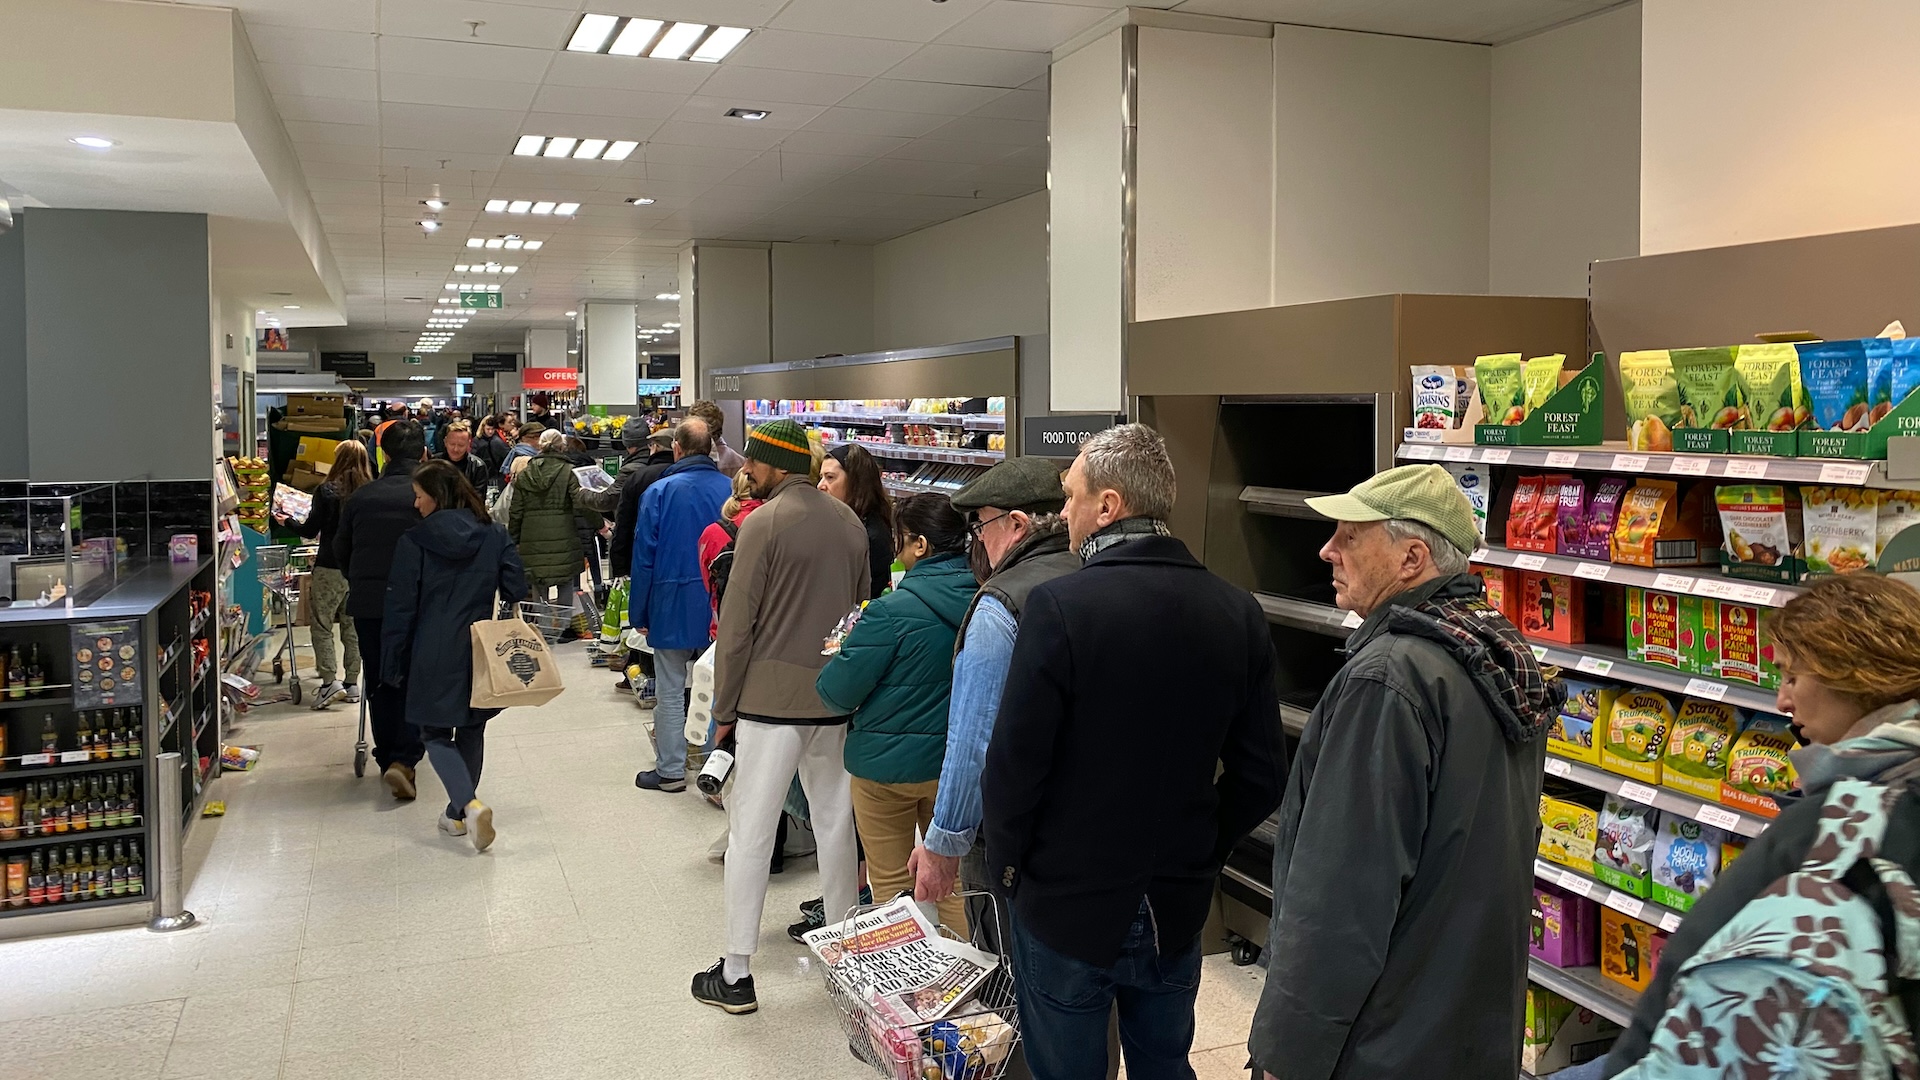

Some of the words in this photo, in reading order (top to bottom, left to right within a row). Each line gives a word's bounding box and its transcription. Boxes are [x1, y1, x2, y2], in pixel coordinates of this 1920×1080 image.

[1685, 363, 1723, 373] FOREST
[1743, 361, 1780, 371] FOREST
[1808, 359, 1852, 370] FOREST
[543, 372, 577, 380] OFFERS
[1482, 369, 1511, 377] FOREST
[1629, 367, 1670, 377] FOREST
[1689, 372, 1721, 382] FEAST
[1745, 370, 1776, 380] FEAST
[1811, 368, 1851, 379] FEAST
[715, 376, 726, 391] FOOD
[726, 376, 733, 391] TO
[733, 376, 740, 391] GO
[1632, 377, 1666, 387] FEAST
[1633, 401, 1659, 409] PEAR
[1544, 412, 1580, 423] FOREST
[1547, 423, 1577, 433] FEAST
[1042, 431, 1064, 444] FOOD
[1065, 431, 1077, 444] TO
[1684, 433, 1713, 441] FOREST
[1744, 436, 1775, 445] FOREST
[1812, 437, 1848, 447] FOREST
[1687, 441, 1711, 449] FEAST
[1747, 444, 1773, 453] FEAST
[1815, 446, 1844, 455] FEAST
[1560, 484, 1581, 496] URBAN
[1599, 483, 1623, 495] URBAN
[1635, 487, 1663, 498] URBAN
[1514, 493, 1535, 503] FRUIT
[1559, 496, 1579, 507] FRUIT
[1594, 492, 1615, 503] FRUIT
[1631, 495, 1660, 509] FRUIT
[1541, 591, 1553, 600] BEAR
[1652, 620, 1669, 629] SOUR
[1648, 625, 1675, 639] RAISIN
[1652, 636, 1670, 647] SNACKS
[1729, 633, 1748, 643] SOUR
[1648, 646, 1676, 655] WATERMELON
[1724, 639, 1755, 654] RAISIN
[1729, 650, 1749, 661] SNACKS
[1724, 661, 1756, 671] WATERMELON
[1629, 695, 1664, 714] Sunny
[1749, 733, 1790, 754] Sunn
[1605, 755, 1617, 765] REAL
[1617, 759, 1633, 769] FRUIT
[1663, 773, 1674, 782] REAL
[1675, 776, 1691, 786] FRUIT
[1722, 788, 1738, 800] REAL
[1738, 793, 1757, 805] FRUIT
[1671, 844, 1706, 867] yogurt
[809, 929, 843, 943] Daily
[854, 916, 883, 930] Mail
[876, 934, 890, 943] this
[889, 925, 917, 939] Sunday
[1623, 936, 1637, 948] BEAR
[836, 947, 901, 976] SCHOOL'S
[909, 951, 948, 974] SOAR
[844, 960, 897, 983] EXAMS
[874, 980, 902, 995] AND
[904, 967, 942, 988] ARMY
[941, 954, 957, 968] IN
